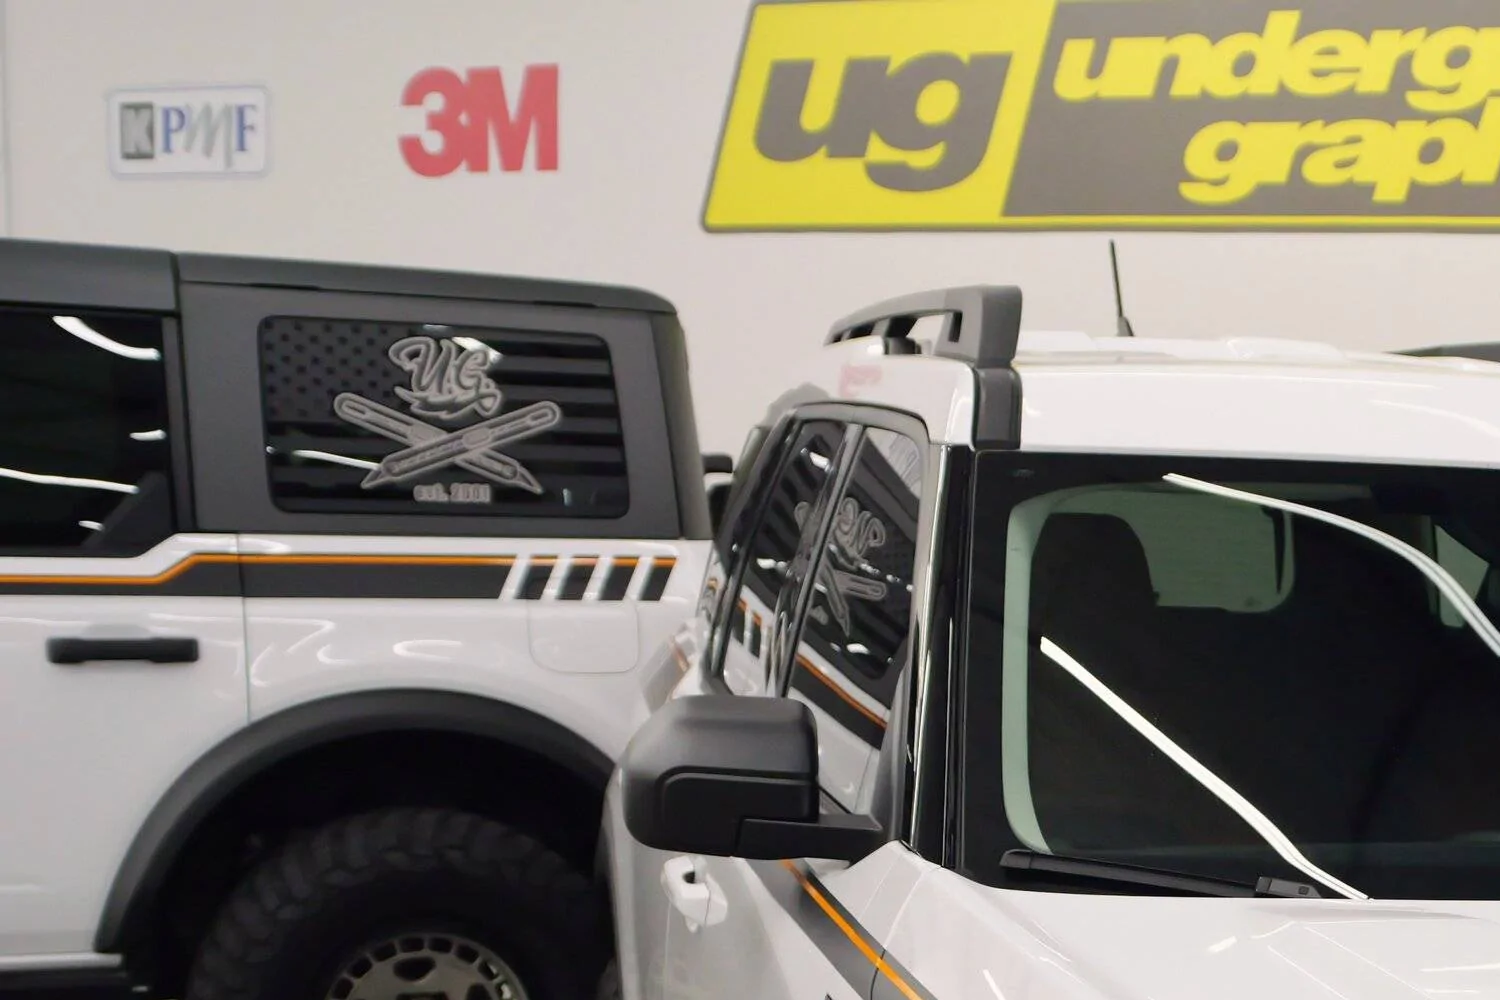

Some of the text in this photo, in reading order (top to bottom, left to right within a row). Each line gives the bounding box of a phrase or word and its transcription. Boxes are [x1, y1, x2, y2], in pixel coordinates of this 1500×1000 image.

[120, 101, 258, 169] KPMF
[398, 63, 559, 178] 3M
[753, 51, 1014, 192] ug
